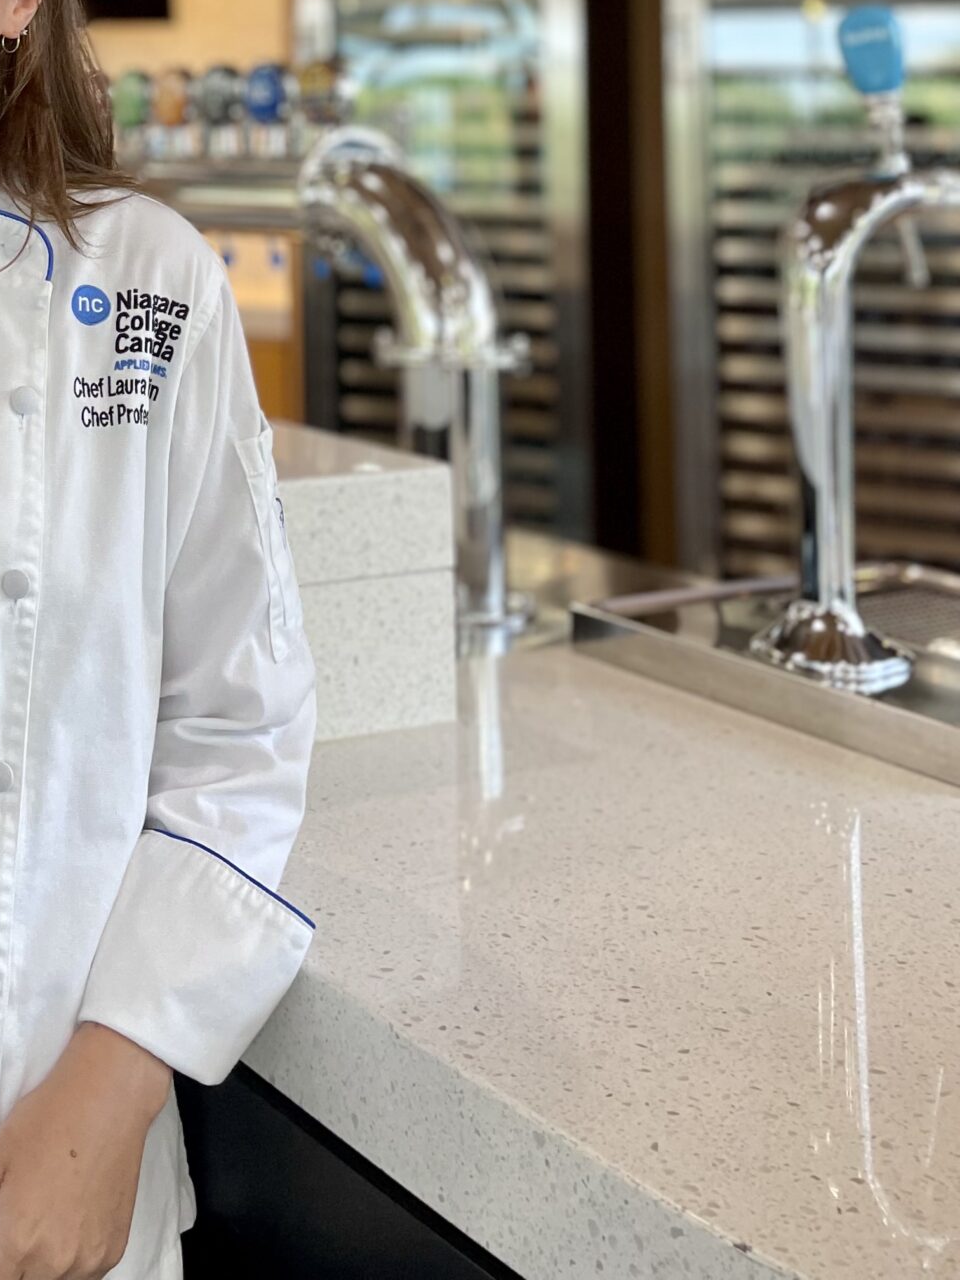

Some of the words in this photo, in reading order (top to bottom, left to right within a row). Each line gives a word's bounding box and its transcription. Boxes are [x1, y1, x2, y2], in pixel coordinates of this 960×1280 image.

[77, 295, 104, 313] nc
[116, 288, 190, 321] Niagara
[114, 332, 174, 363] Canda
[73, 376, 104, 398] Chef
[107, 375, 147, 397] Laura
[81, 405, 114, 428] Chef
